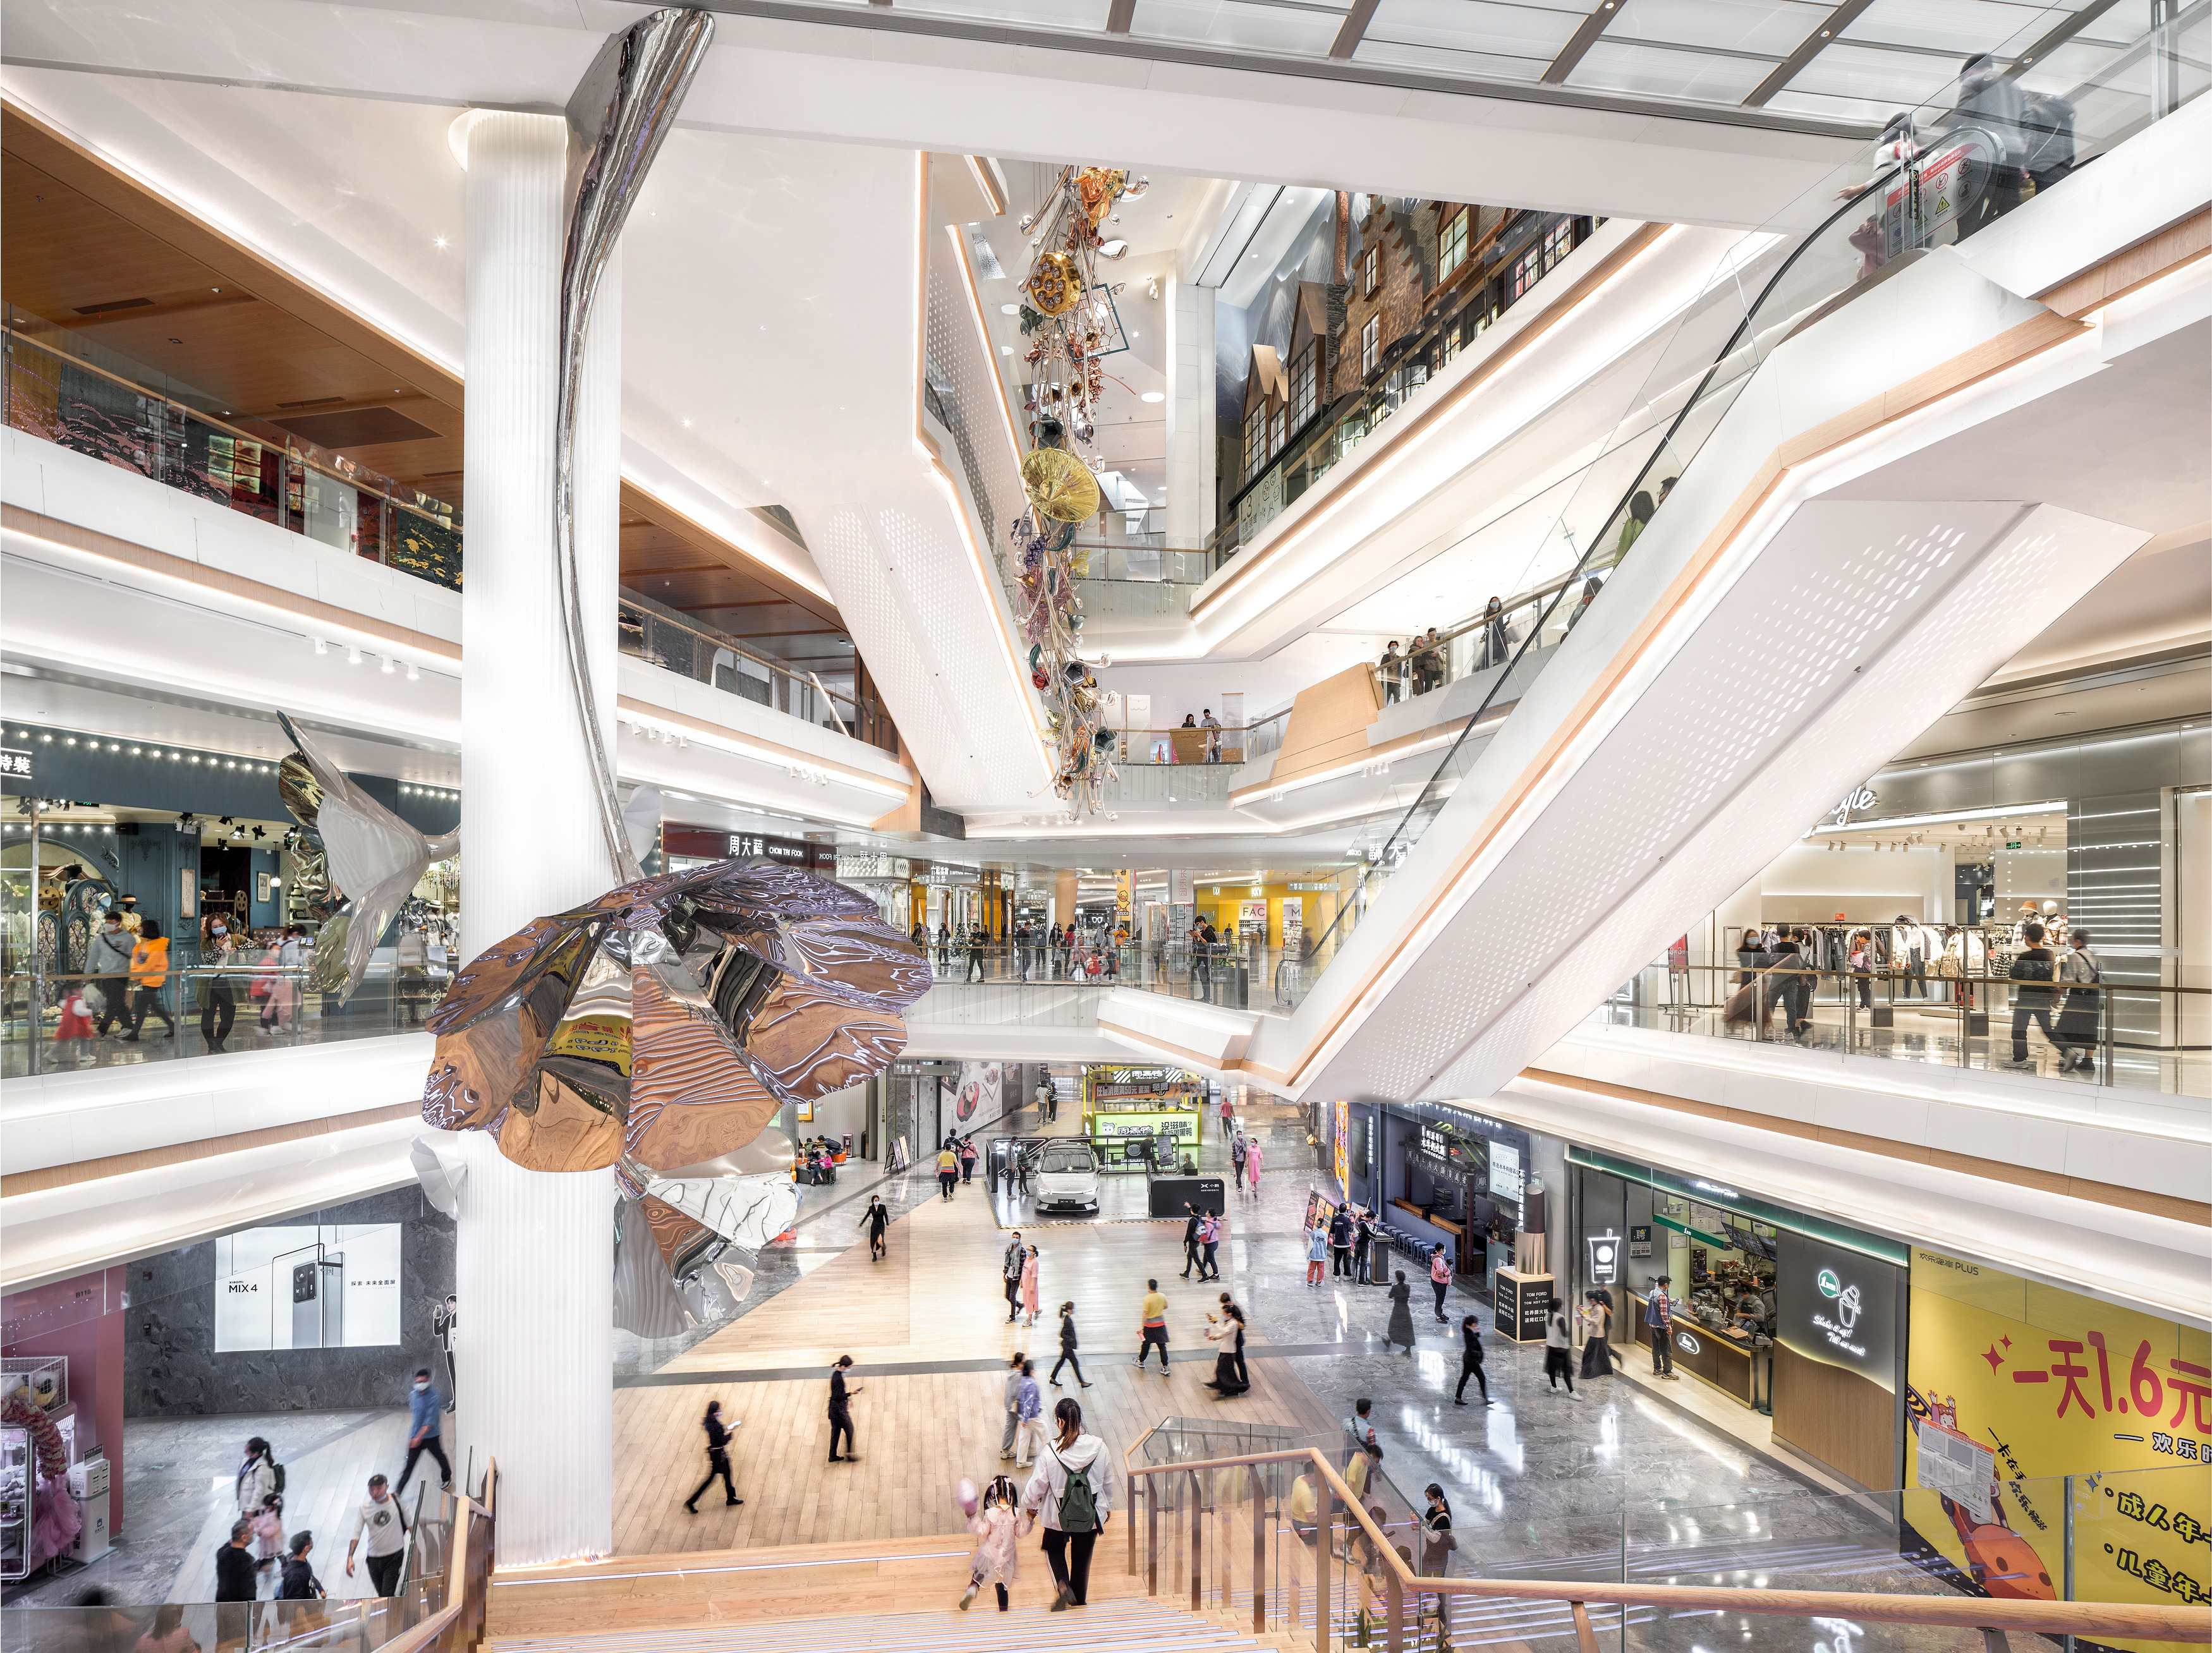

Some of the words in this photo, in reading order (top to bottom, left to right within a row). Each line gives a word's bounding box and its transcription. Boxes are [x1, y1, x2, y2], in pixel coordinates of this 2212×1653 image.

[1241, 494, 1252, 522] L3
[729, 835, 763, 856] 周大福
[769, 847, 782, 855] CHOW
[1152, 1082, 1169, 1092] 免费
[1117, 1125, 1153, 1134] 周黑鸭
[1919, 1252, 1953, 1268] 欢乐海岸
[1955, 1262, 1979, 1276] PLUS
[229, 1285, 249, 1293] MIX
[250, 1284, 258, 1292] 4
[76, 1289, 91, 1298] B118
[2012, 1330, 2211, 1435] 一天1.6元
[1, 1503, 9, 1511] 换
